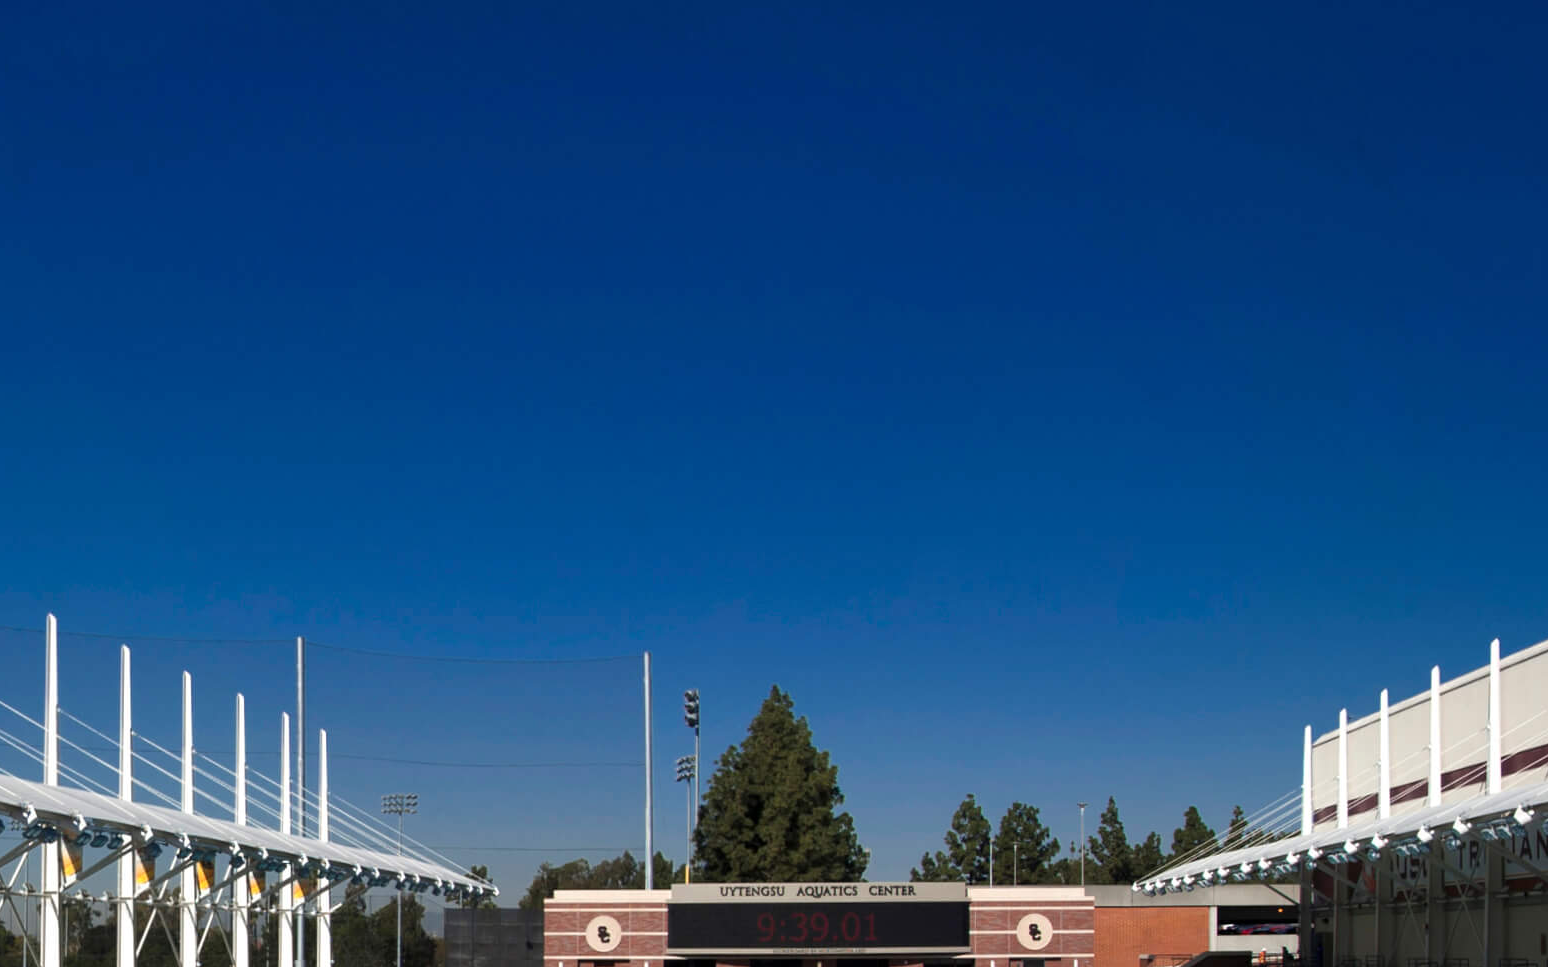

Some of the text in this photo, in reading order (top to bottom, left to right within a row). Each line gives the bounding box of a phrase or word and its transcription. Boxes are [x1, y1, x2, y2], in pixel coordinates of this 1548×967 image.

[720, 885, 916, 899] UYTENGSU AQUATICS CENTER
[756, 911, 879, 943] 9:39.01
